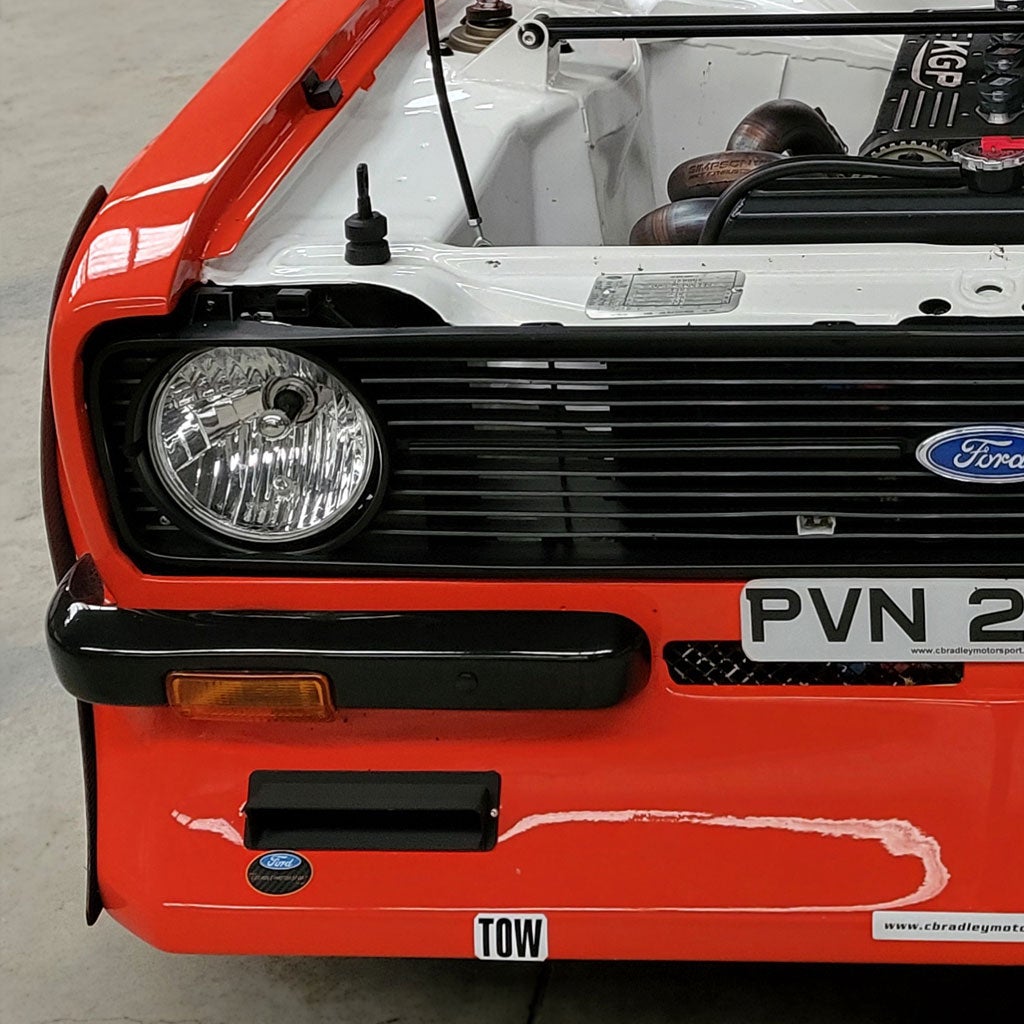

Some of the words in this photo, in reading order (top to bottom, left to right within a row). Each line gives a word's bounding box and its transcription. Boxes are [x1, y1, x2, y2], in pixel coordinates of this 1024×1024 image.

[925, 39, 971, 88] KGP
[688, 159, 752, 174] SIMPSON
[745, 587, 927, 643] PVN
[266, 855, 295, 868] Ford
[476, 917, 543, 959] TOW
